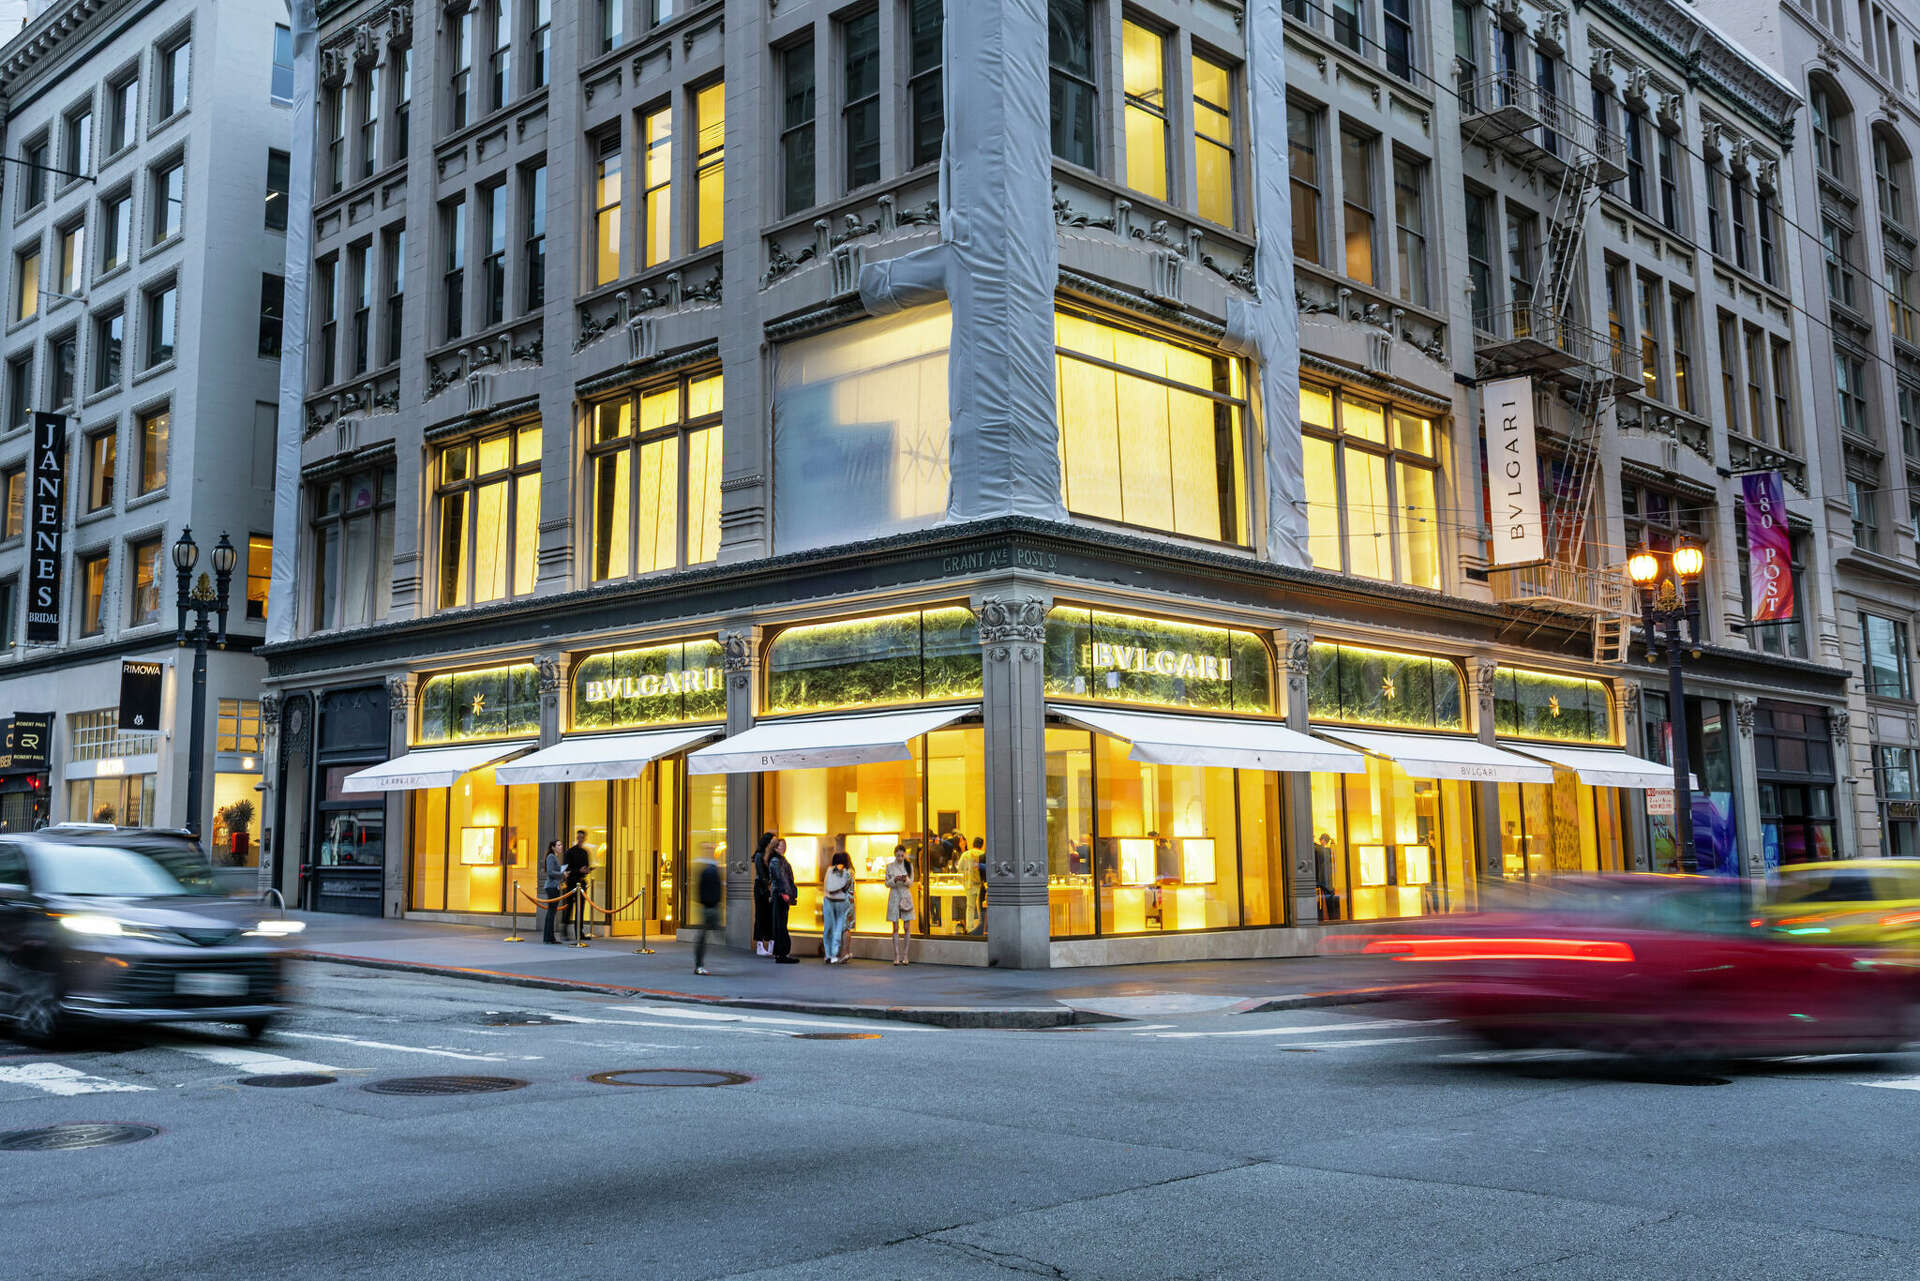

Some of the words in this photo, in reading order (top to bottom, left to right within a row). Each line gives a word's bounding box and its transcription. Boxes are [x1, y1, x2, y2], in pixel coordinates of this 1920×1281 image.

[1502, 401, 1525, 540] BVLGARI
[35, 424, 61, 607] JANENES
[1759, 481, 1773, 529] 180
[943, 552, 985, 573] GRANT
[1017, 549, 1044, 568] POST
[1763, 548, 1780, 611] POST
[29, 611, 59, 624] BRIDAL
[123, 664, 161, 676] RIMOWA
[1092, 642, 1233, 681] BVLGARI
[585, 667, 716, 703] BVLGARI
[1460, 766, 1497, 777] BVLGARI
